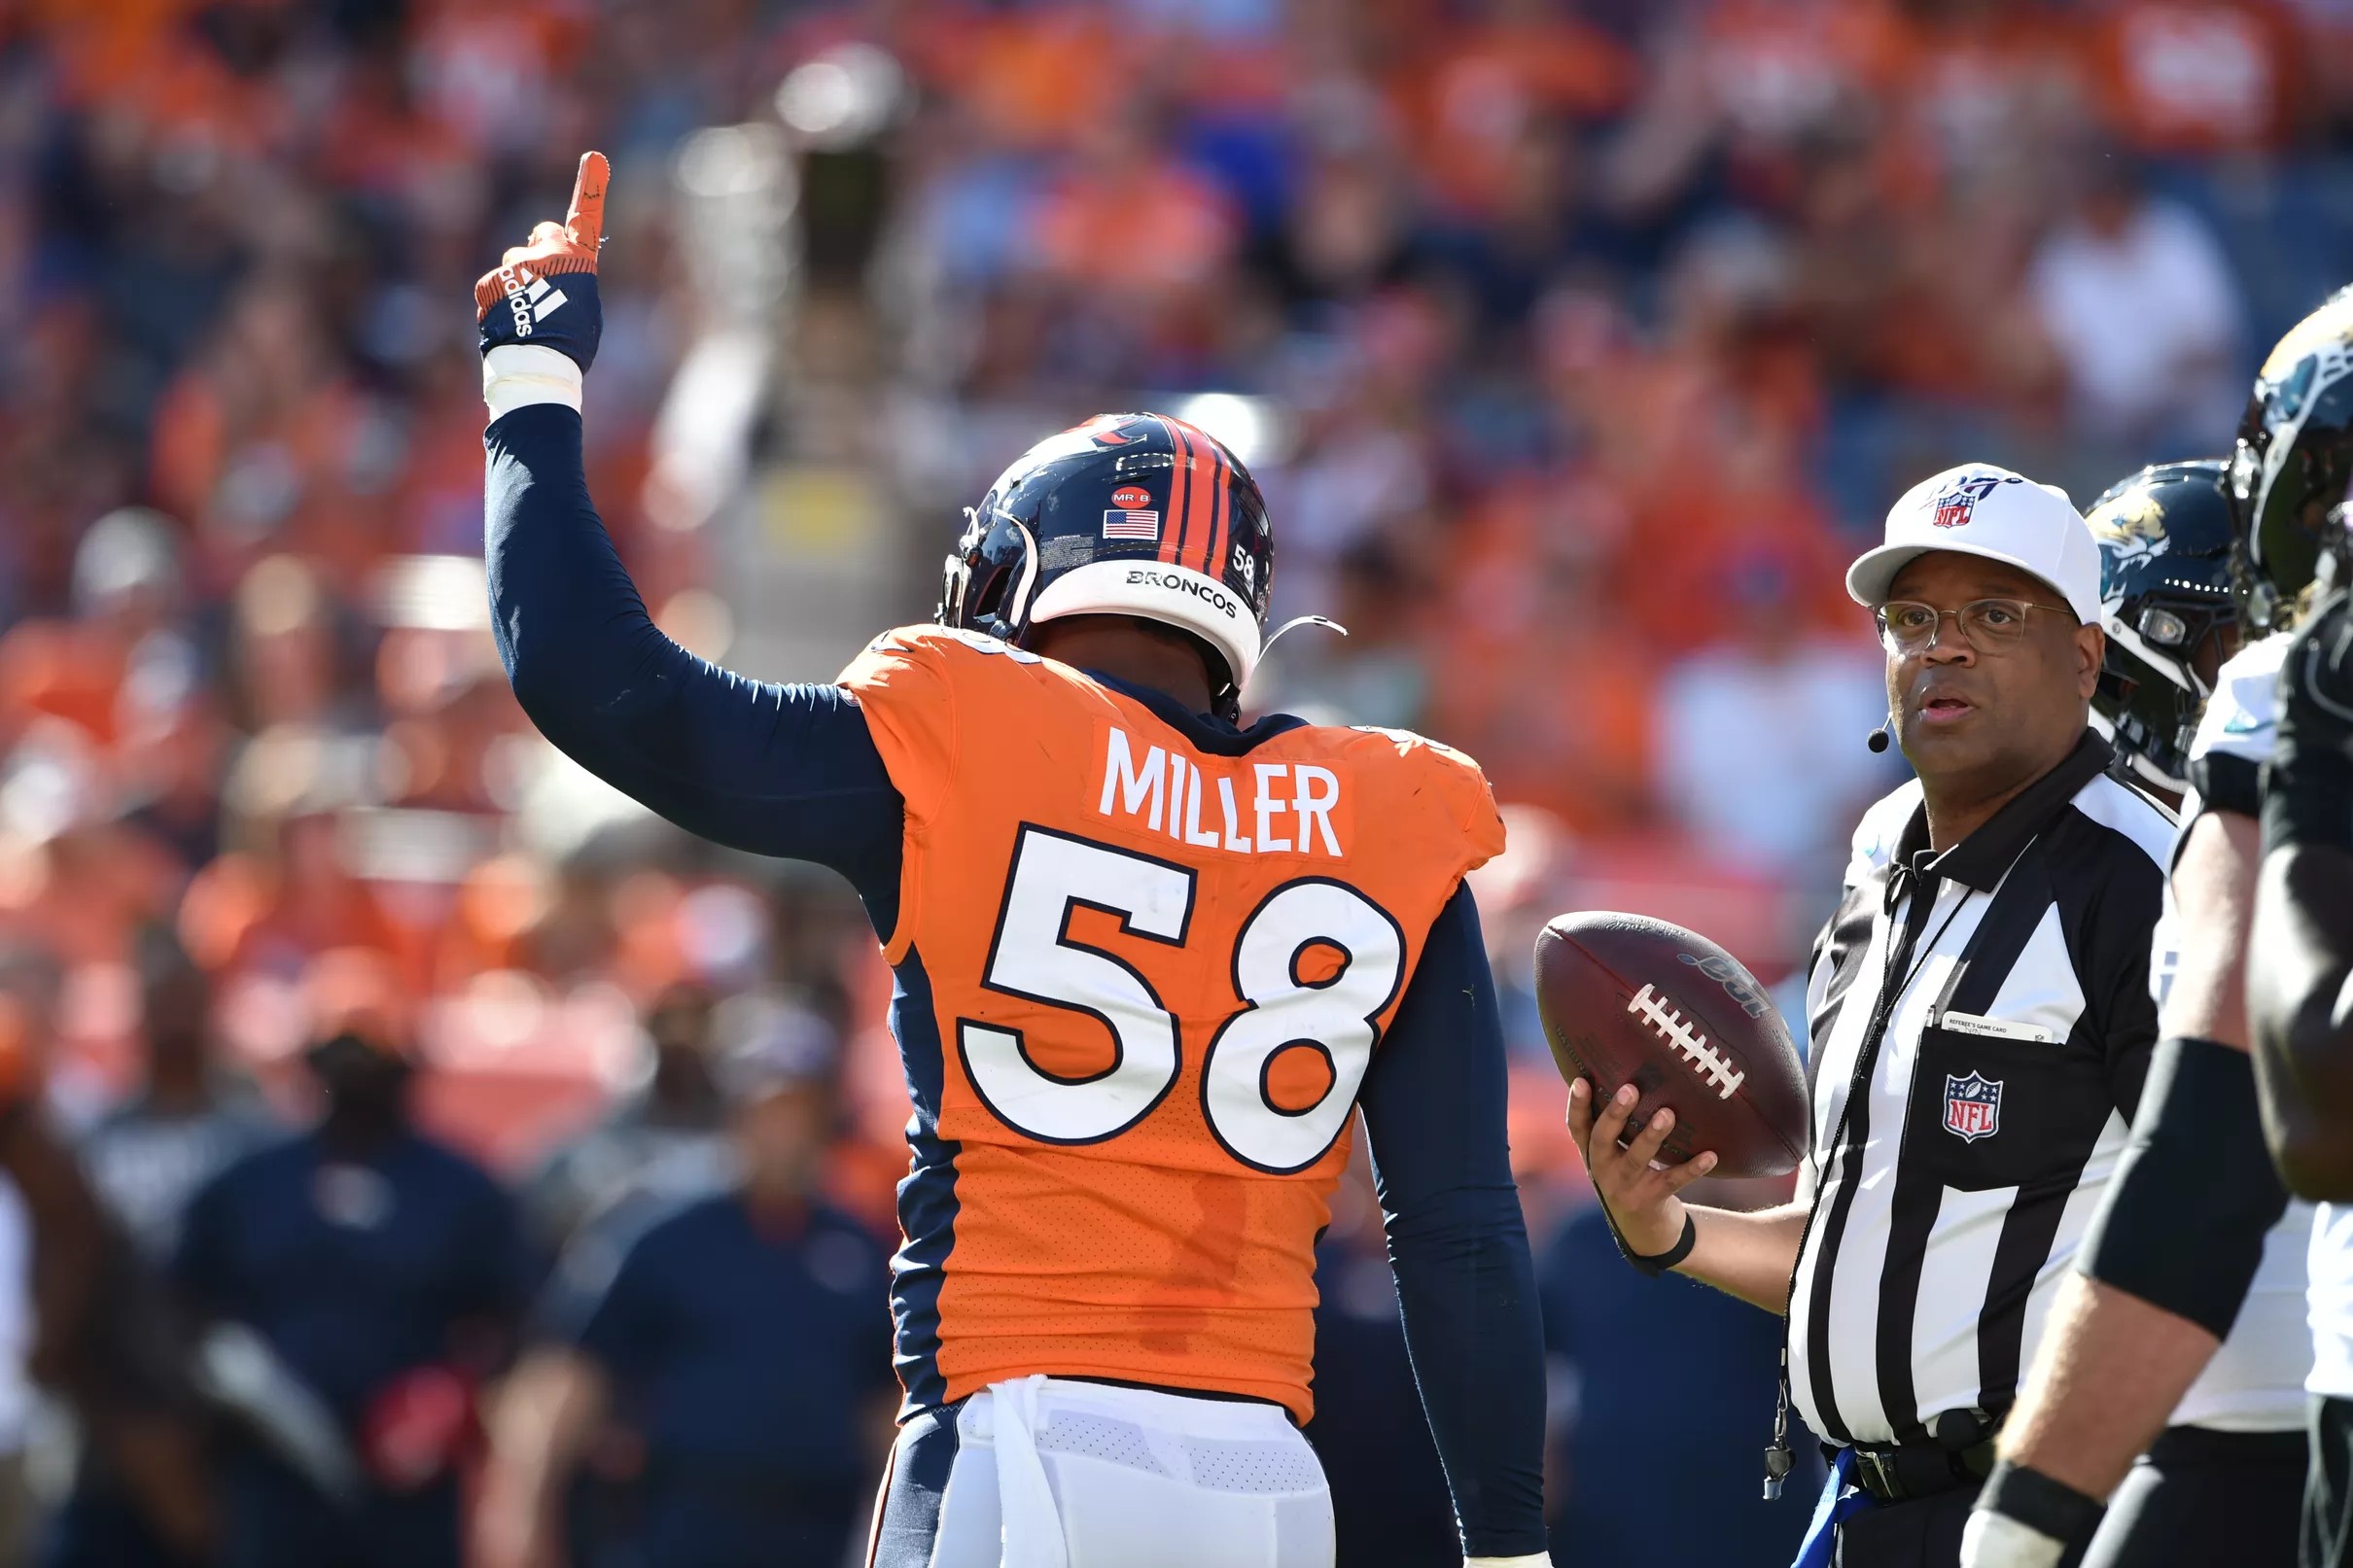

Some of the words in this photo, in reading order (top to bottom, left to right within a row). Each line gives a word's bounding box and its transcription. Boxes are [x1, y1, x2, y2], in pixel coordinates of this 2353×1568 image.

[499, 266, 533, 337] adidas
[1937, 505, 1970, 526] NFL
[1233, 543, 1254, 580] 58
[1126, 571, 1237, 618] BRONCOS
[1099, 726, 1342, 856] MILLER
[956, 820, 1407, 1176] 58
[1949, 1019, 1976, 1028] REFEREE'S
[1949, 1100, 1992, 1132] NFL
